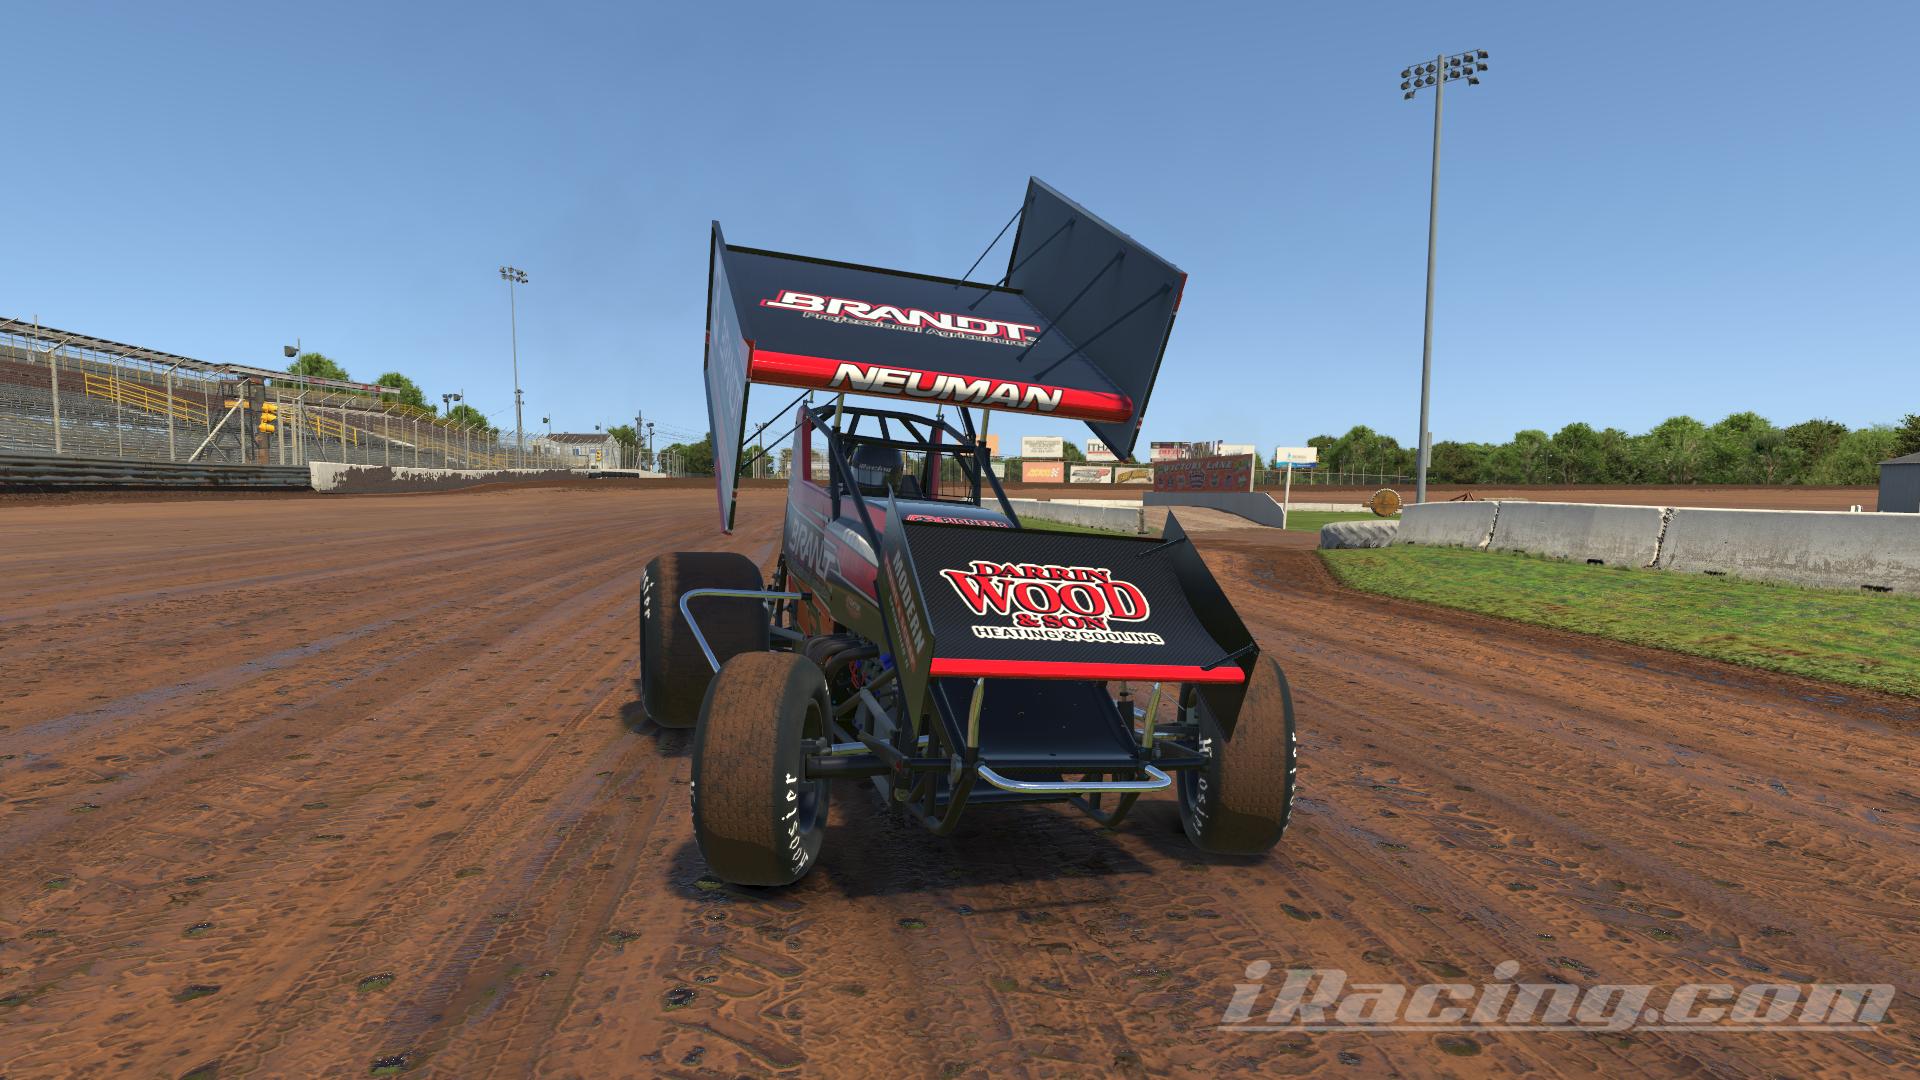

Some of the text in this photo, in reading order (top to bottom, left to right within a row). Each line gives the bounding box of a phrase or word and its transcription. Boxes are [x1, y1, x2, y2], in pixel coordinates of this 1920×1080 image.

[761, 290, 1039, 340] BRANDT
[802, 311, 922, 333] Professional
[829, 362, 1063, 412] NEUMAN
[941, 569, 1149, 621] WOOD
[970, 561, 1110, 583] DARRIN
[892, 551, 926, 655] MODERN
[974, 626, 1058, 641] HEATING
[1079, 631, 1163, 645] COOLING
